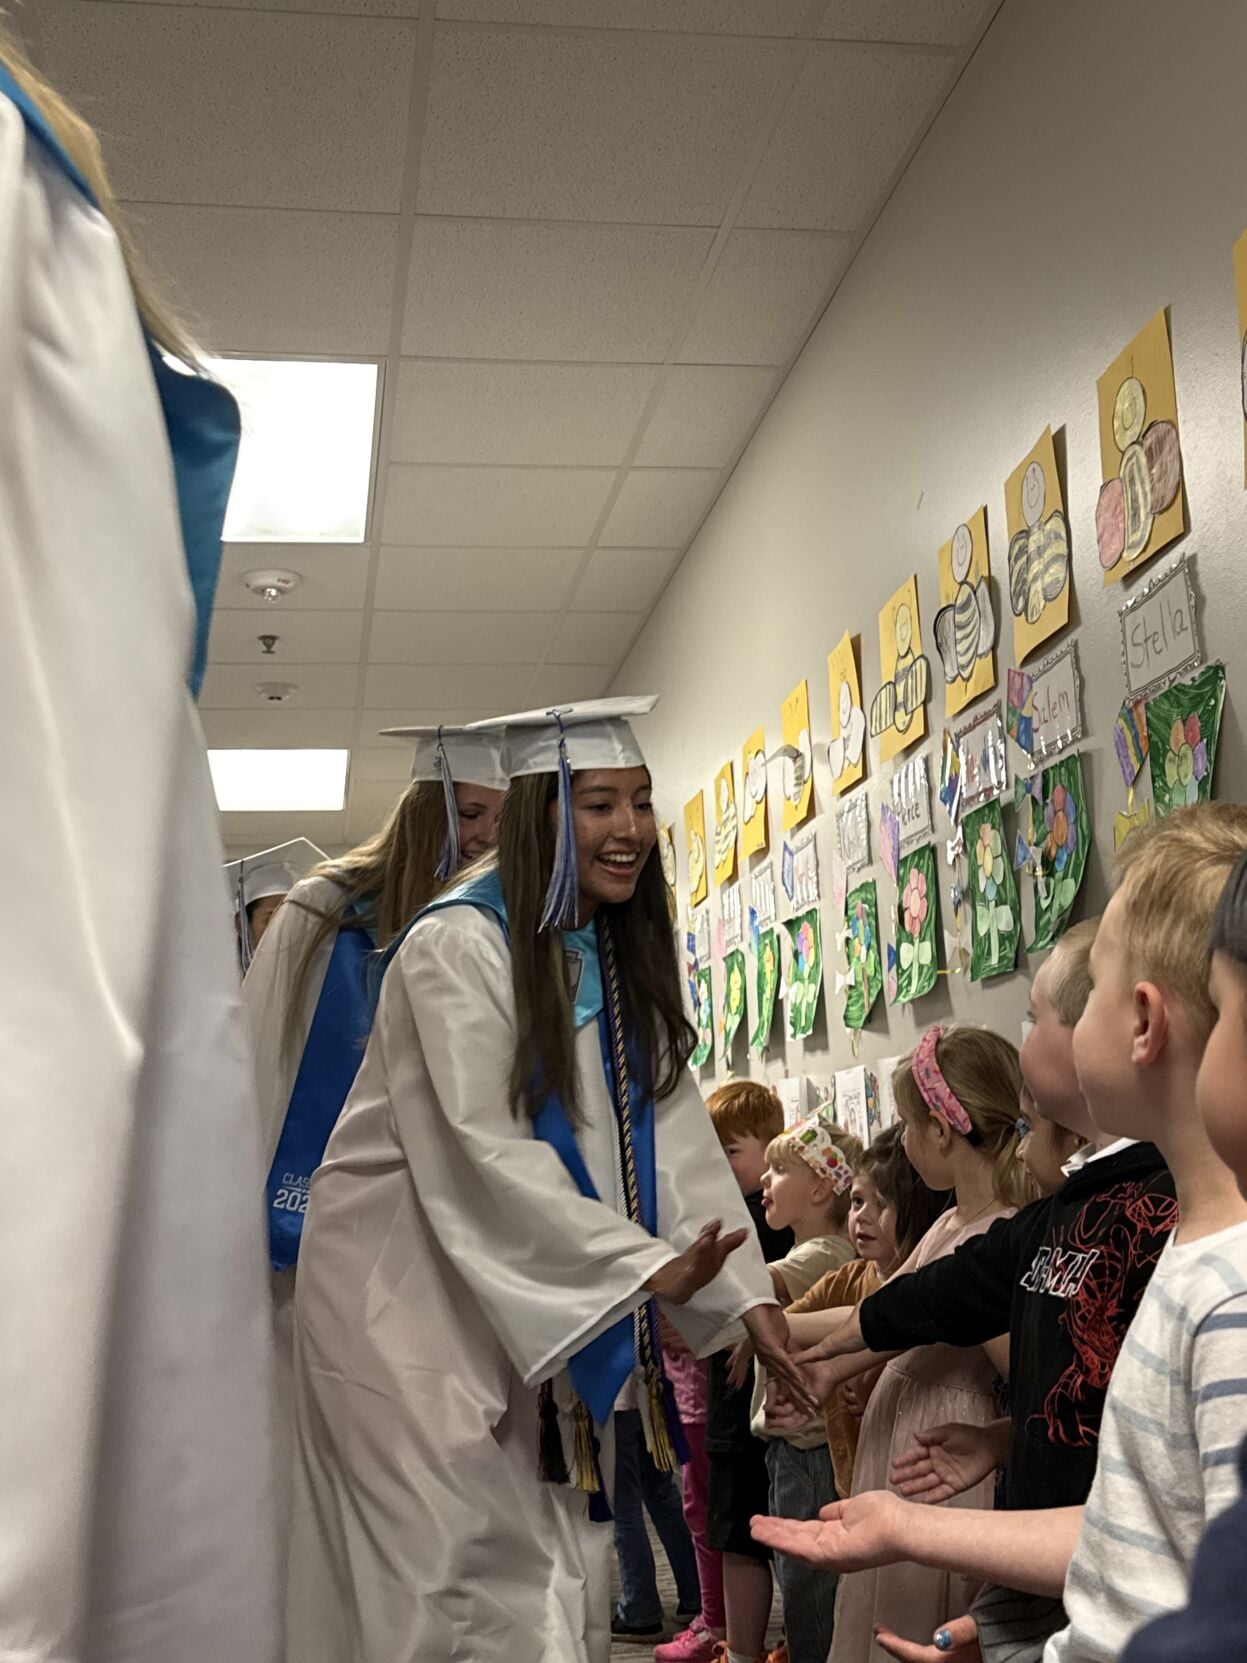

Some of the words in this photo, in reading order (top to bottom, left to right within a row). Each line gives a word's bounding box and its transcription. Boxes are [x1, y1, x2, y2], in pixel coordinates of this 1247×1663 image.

[1130, 595, 1188, 669] Stella
[1031, 685, 1070, 733] Salem
[282, 1172, 310, 1188] CLAS
[273, 1188, 310, 1213] 202
